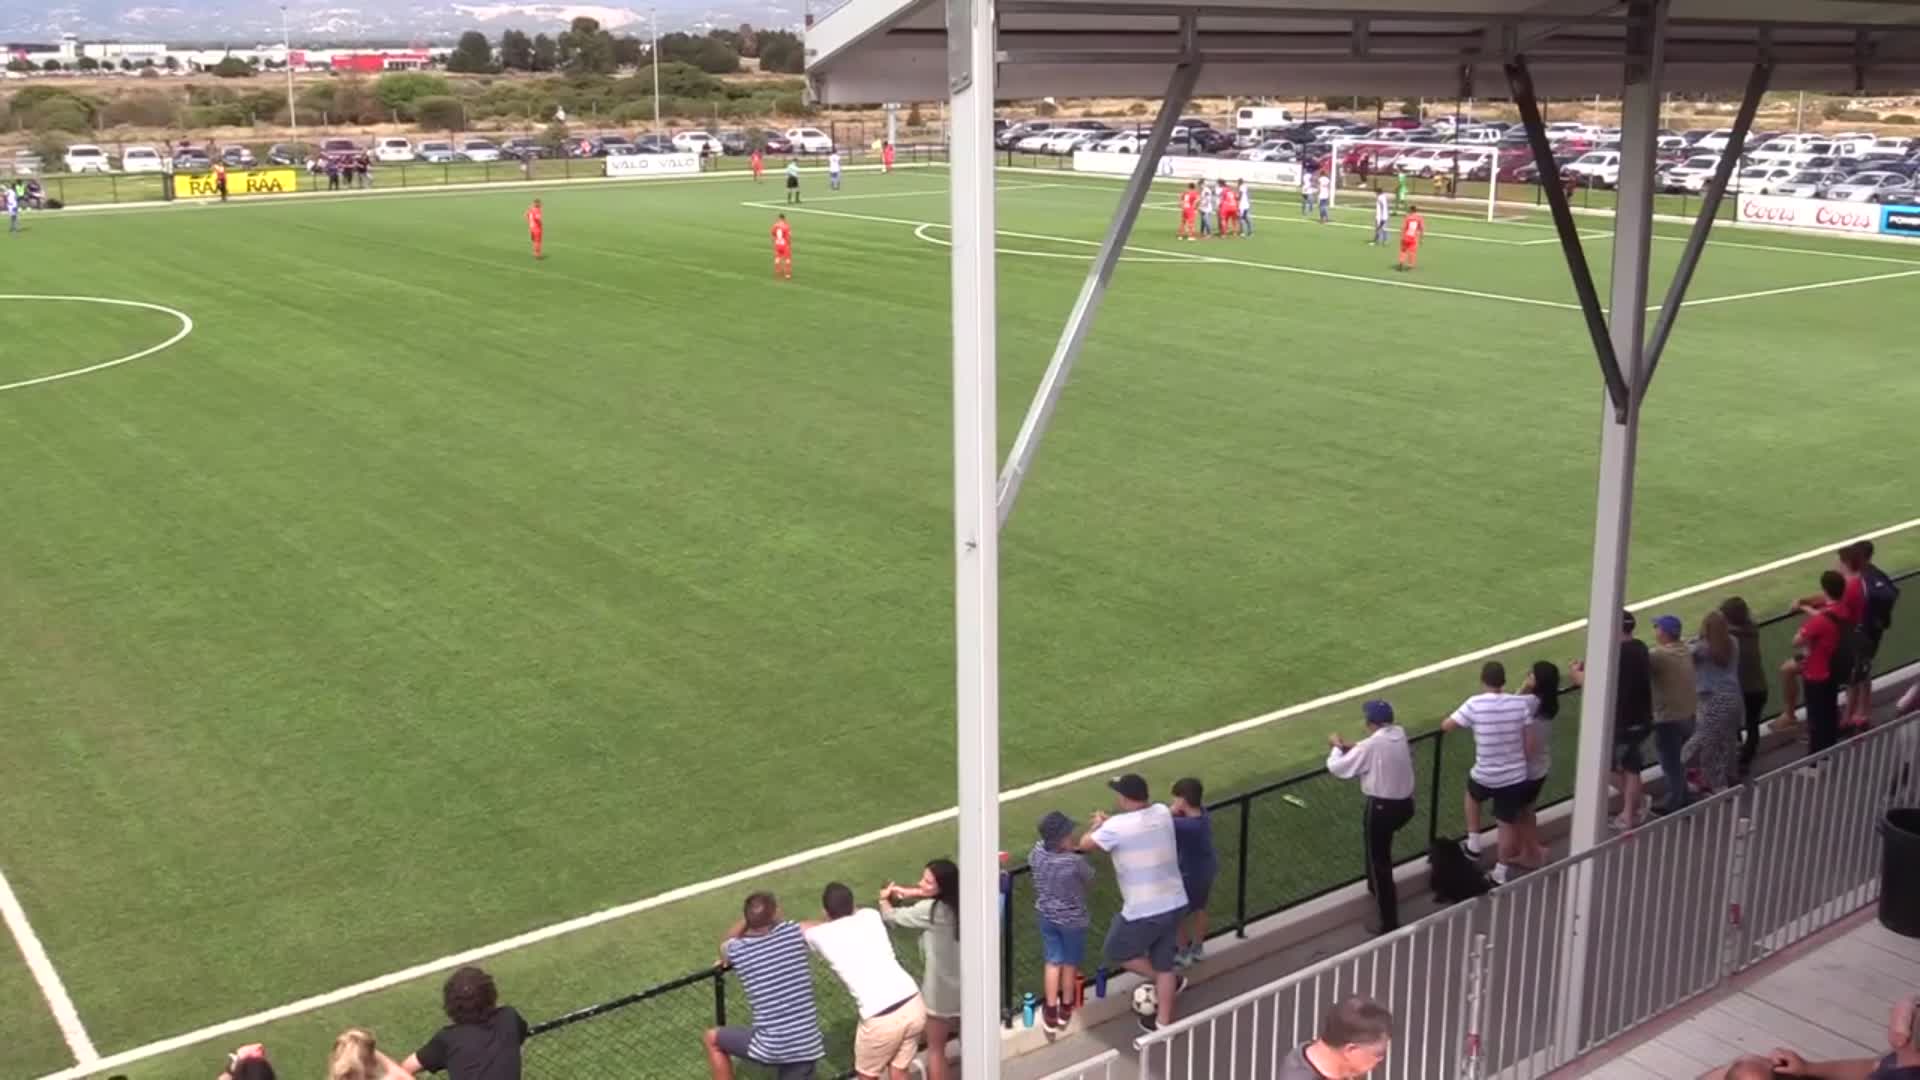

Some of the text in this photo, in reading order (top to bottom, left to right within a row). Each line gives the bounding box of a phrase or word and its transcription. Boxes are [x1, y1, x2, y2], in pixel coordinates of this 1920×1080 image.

[246, 178, 283, 193] RAA
[1743, 199, 1871, 228] Coors Coors
